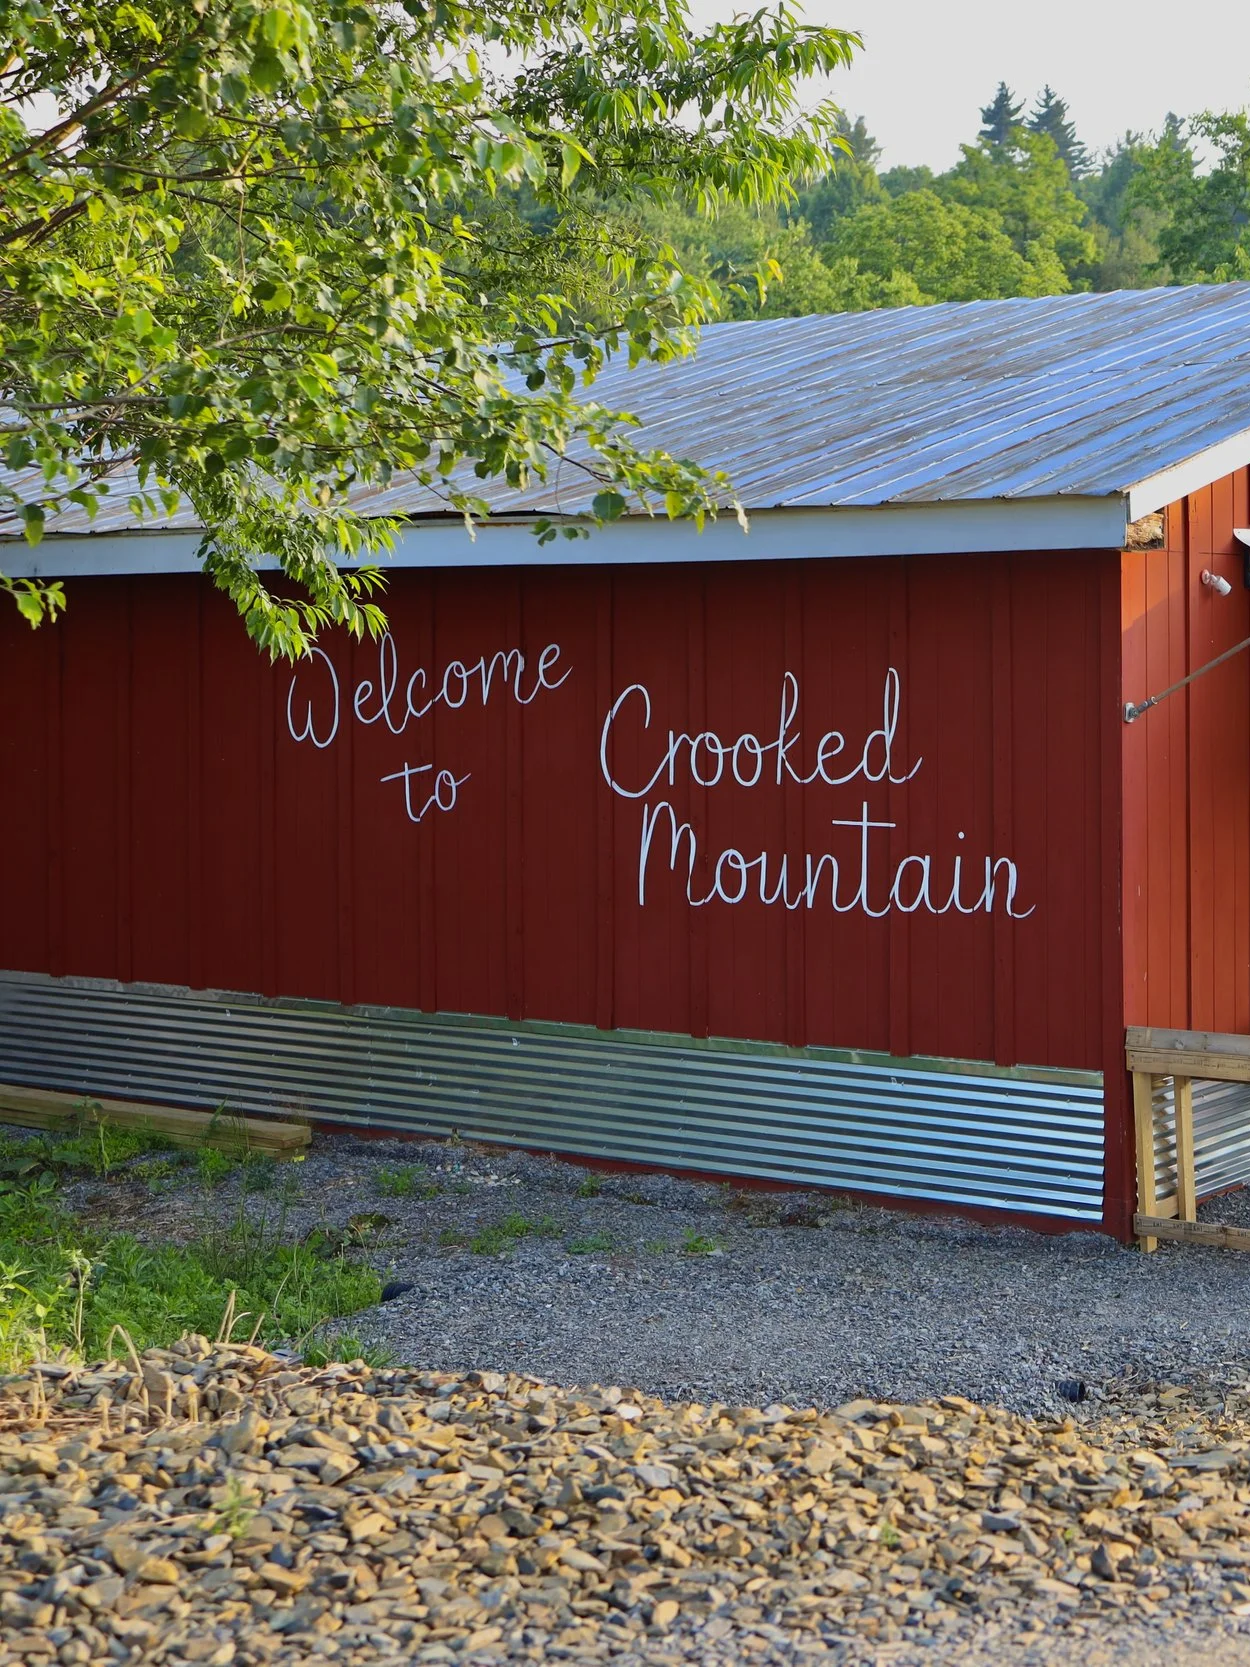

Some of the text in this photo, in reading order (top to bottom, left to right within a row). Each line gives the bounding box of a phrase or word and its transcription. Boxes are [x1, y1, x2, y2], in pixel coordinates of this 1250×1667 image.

[286, 632, 572, 748] Welcome
[600, 667, 923, 798] Crooked
[381, 762, 471, 822] to
[638, 802, 1036, 919] Mountain
